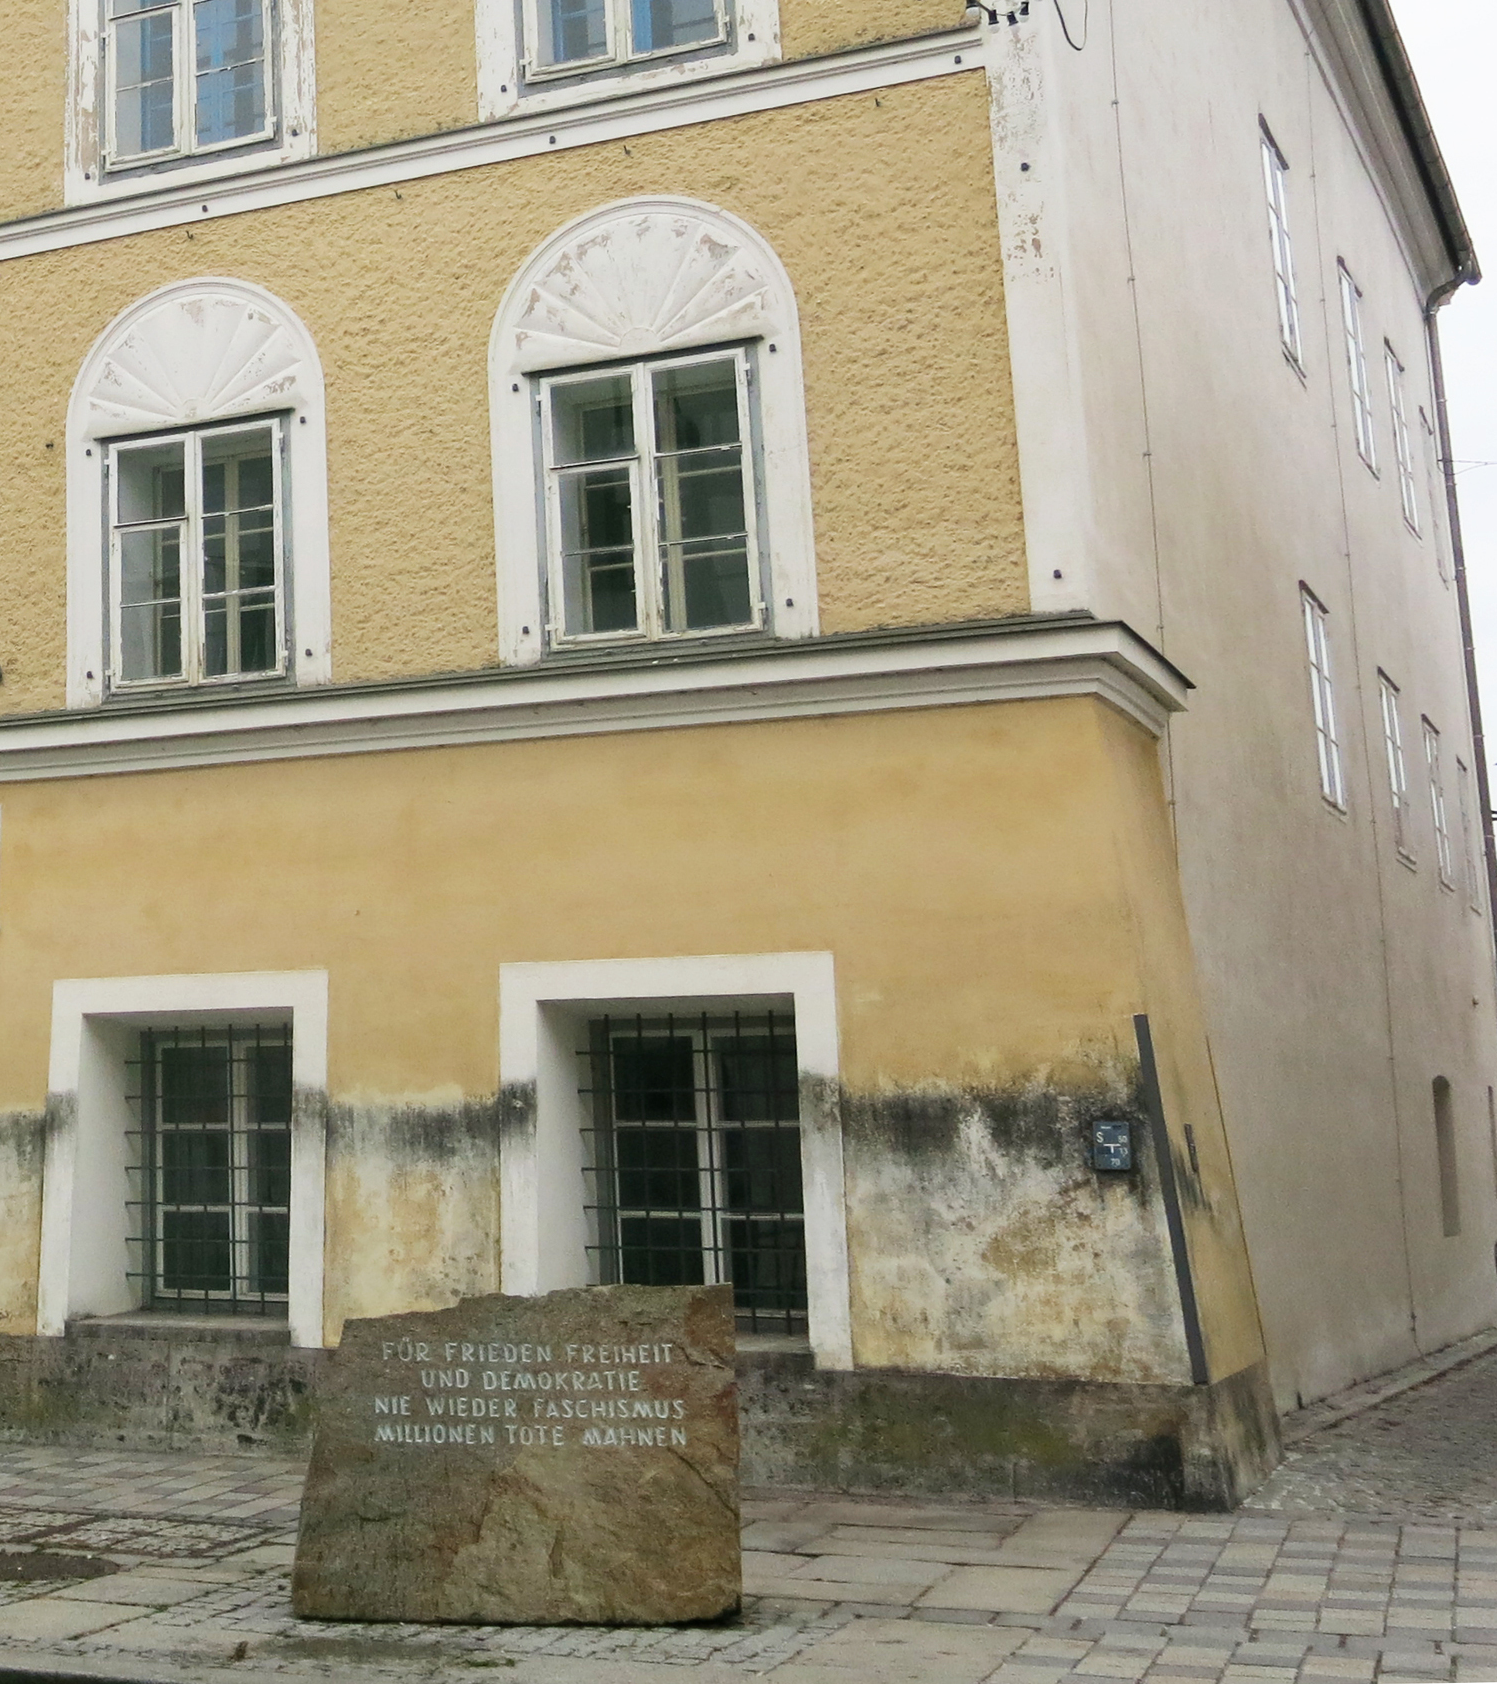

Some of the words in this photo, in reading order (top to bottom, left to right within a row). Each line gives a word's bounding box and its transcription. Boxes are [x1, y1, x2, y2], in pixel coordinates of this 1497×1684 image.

[1096, 1131, 1104, 1143] S
[382, 1337, 431, 1362] FÜR
[445, 1342, 551, 1363] FRIEDEN
[565, 1343, 673, 1364] FREIHEIT
[420, 1368, 469, 1388] UND
[482, 1370, 640, 1392] DEMOKRATIE
[374, 1396, 411, 1416] NIE
[425, 1398, 517, 1418] WIEDER
[533, 1399, 685, 1419] FASCHISMUS
[374, 1424, 495, 1445] MILLIONEN
[505, 1425, 564, 1446] TOTE
[583, 1426, 687, 1447] MAHNEN
